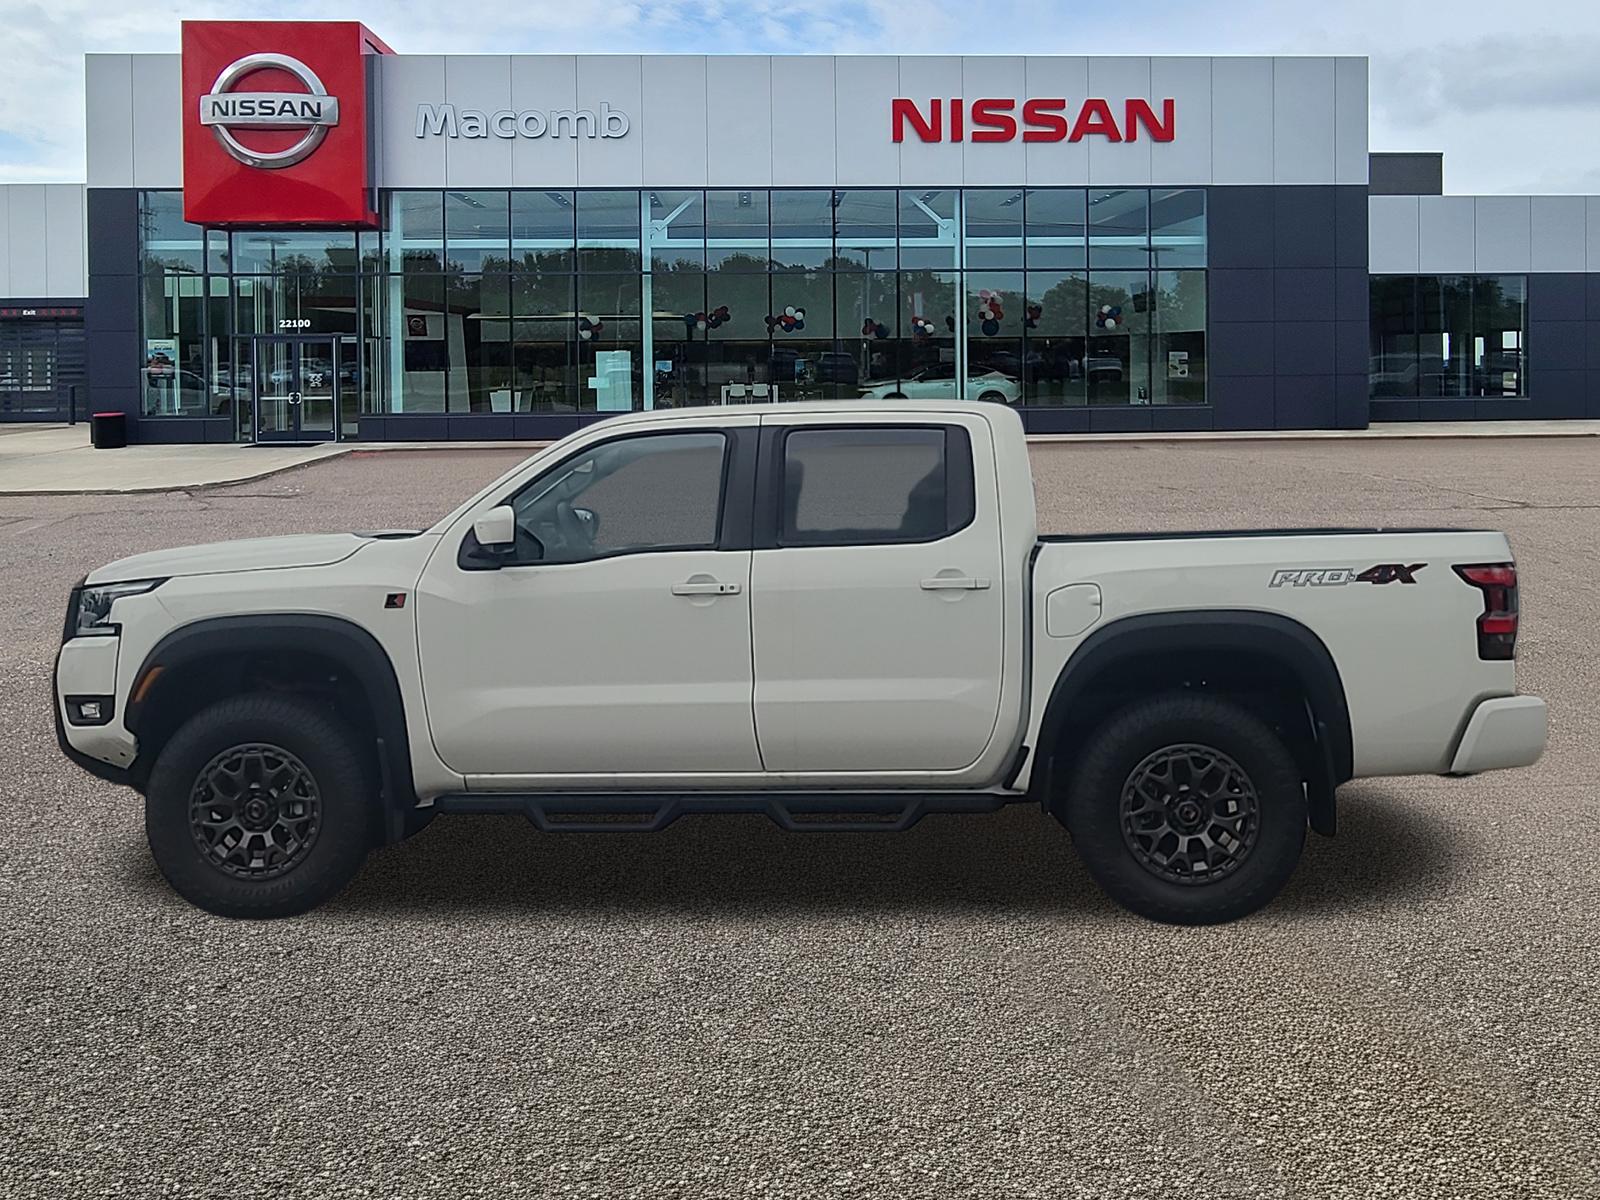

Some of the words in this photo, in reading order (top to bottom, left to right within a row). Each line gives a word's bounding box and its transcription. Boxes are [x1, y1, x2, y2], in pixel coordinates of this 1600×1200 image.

[212, 100, 322, 117] NISSAN
[415, 102, 630, 139] Macomb
[892, 98, 1175, 142] NISSAN
[279, 319, 311, 328] 22100
